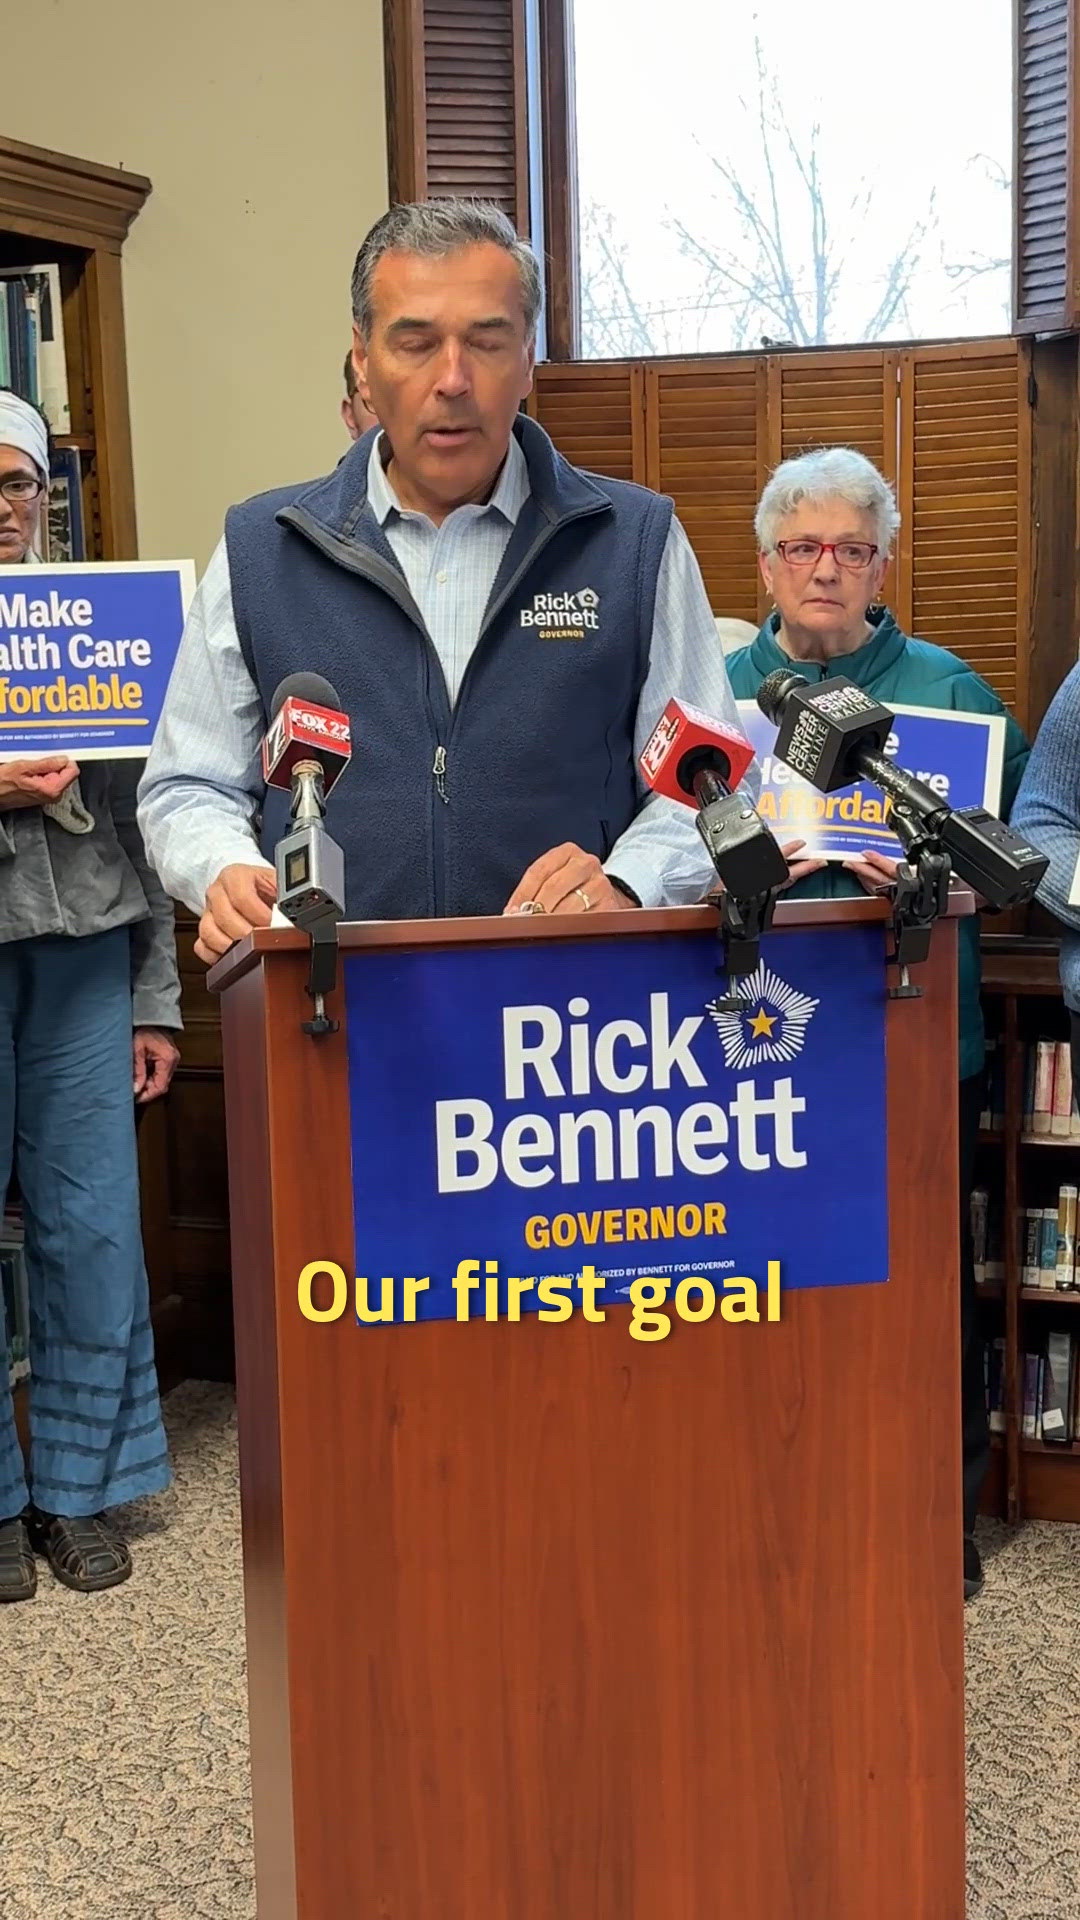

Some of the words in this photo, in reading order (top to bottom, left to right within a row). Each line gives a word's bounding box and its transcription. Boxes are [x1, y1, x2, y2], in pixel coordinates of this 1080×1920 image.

[0, 590, 93, 628] Make
[534, 592, 577, 611] Rick
[520, 608, 599, 629] Bennett
[539, 630, 584, 639] GOVERNOR
[68, 633, 151, 669] Care
[808, 690, 844, 707] NEWS
[819, 692, 868, 712] CENTER
[830, 700, 875, 719] MAINE
[290, 708, 329, 733] FOX
[330, 721, 350, 739] 22
[786, 724, 804, 765] NEWS
[795, 714, 819, 770] CENTER
[805, 724, 828, 775] MAINE
[502, 992, 708, 1100] Rick
[436, 1077, 808, 1194] Bennett
[525, 1202, 728, 1249] GOVERNOR
[626, 1267, 637, 1276] BY
[637, 1264, 673, 1276] BENNETT
[674, 1263, 691, 1272] FOR
[691, 1260, 735, 1271] GOVERNOR
